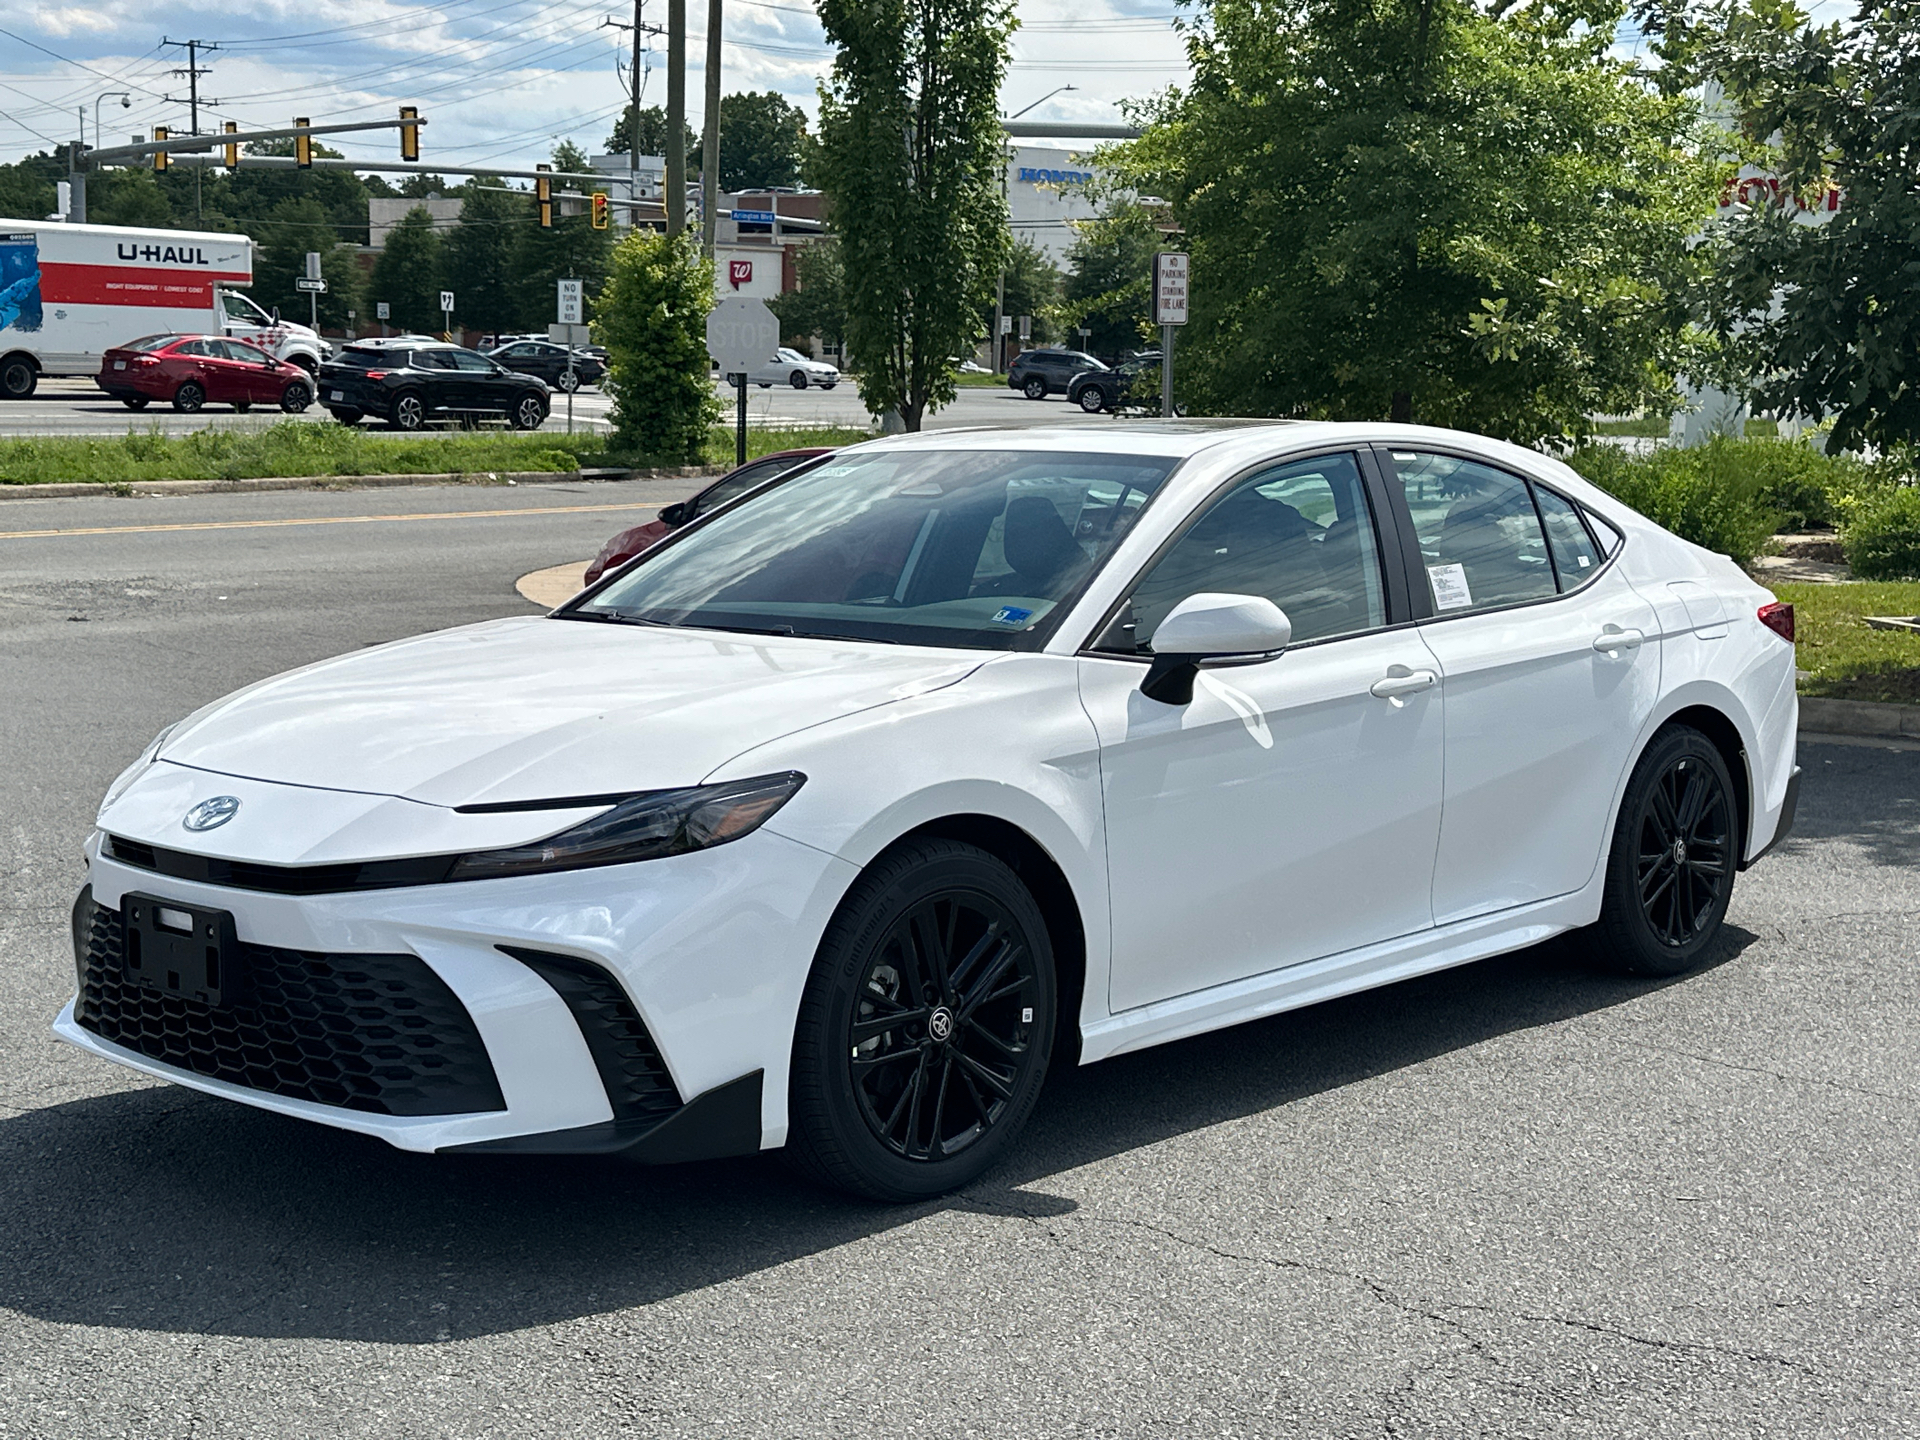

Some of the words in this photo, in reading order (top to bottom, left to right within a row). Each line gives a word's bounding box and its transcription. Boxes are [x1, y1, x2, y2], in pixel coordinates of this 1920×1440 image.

[733, 212, 760, 221] Arlington
[761, 213, 773, 221] Blvd
[117, 243, 209, 265] U-HAUL
[1169, 257, 1179, 267] NO
[1161, 269, 1186, 279] PARKING
[125, 283, 158, 291] EQUIPMENT
[164, 285, 187, 293] LOWEST
[564, 283, 576, 292] NO
[1162, 286, 1184, 296] STANDING
[562, 294, 578, 302] TURN
[1171, 298, 1185, 309] LANE
[564, 313, 576, 321] RED
[713, 322, 774, 348] STOP
